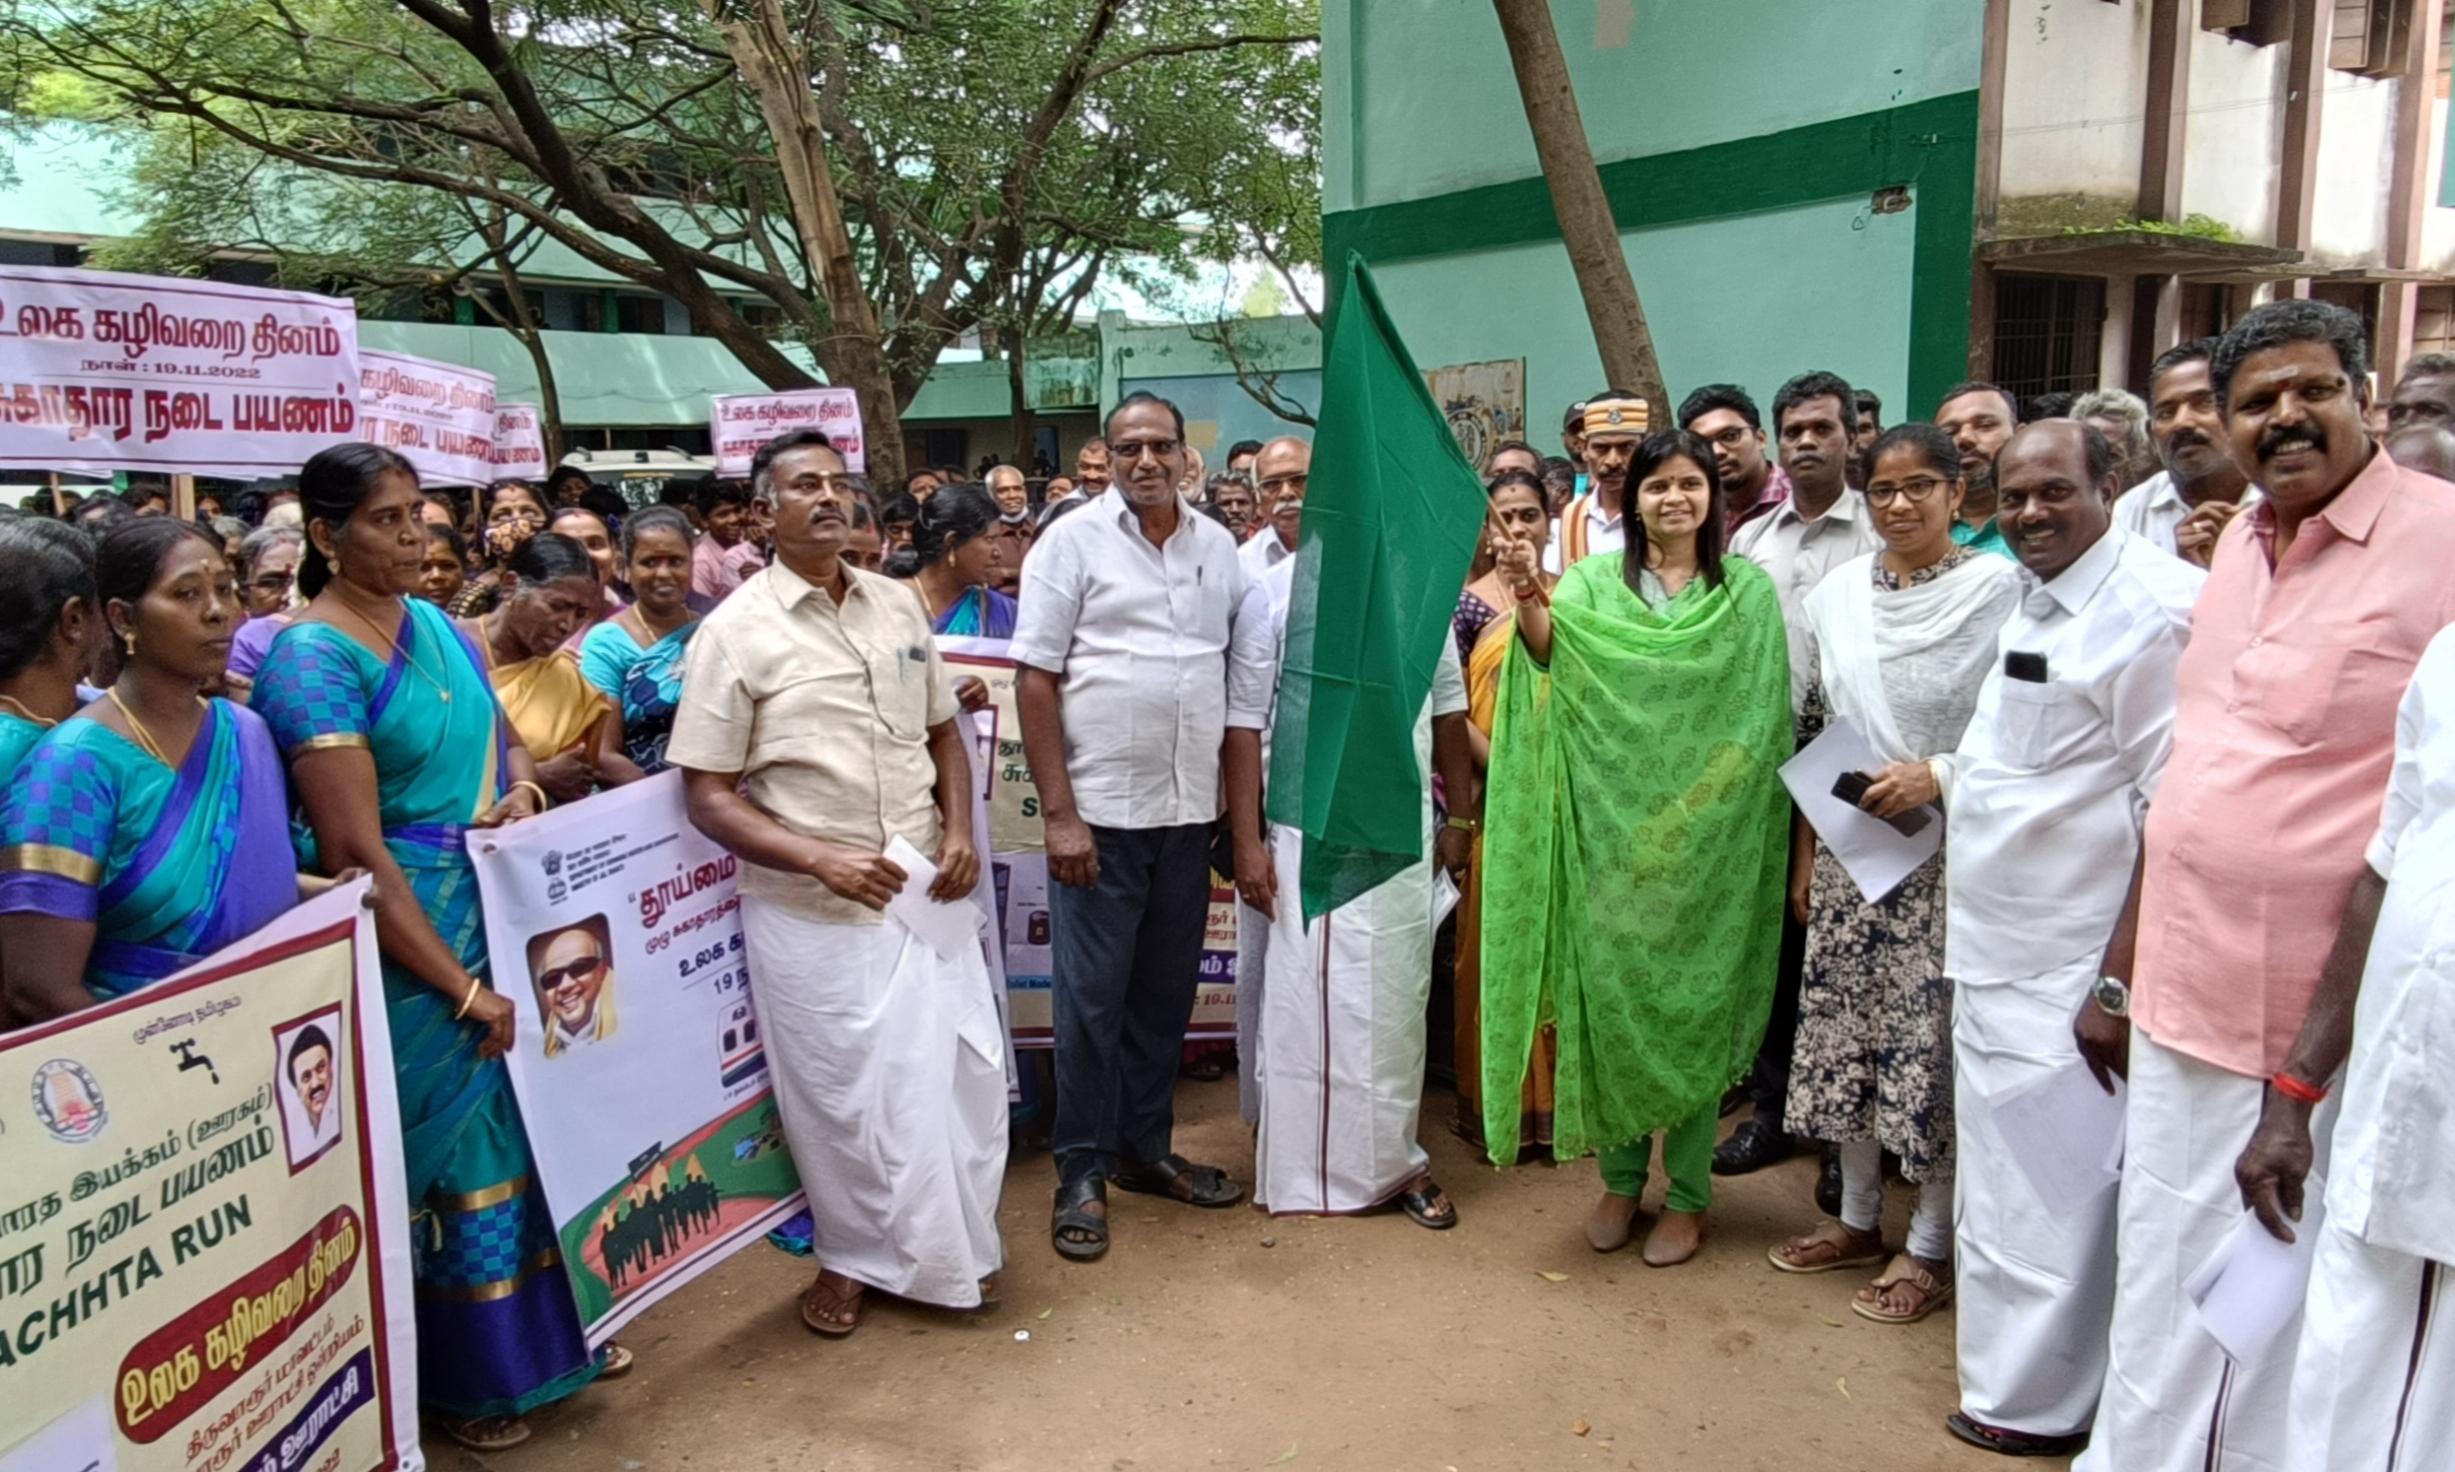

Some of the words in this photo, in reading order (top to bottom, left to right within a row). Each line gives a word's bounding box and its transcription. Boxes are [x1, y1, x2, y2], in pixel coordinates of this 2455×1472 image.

[94, 302, 245, 361] கழிவறை
[252, 313, 340, 364] தினம்
[80, 358, 137, 373] நாள்
[154, 363, 261, 379] 19.11.2022
[450, 381, 496, 414] தினம்
[144, 389, 223, 443] நடை
[233, 382, 354, 434] பயணம்
[679, 941, 726, 977] உலக
[65, 1194, 152, 1278] நடை
[161, 1114, 274, 1210] பயணம்
[70, 1129, 182, 1202] இயக்கம்
[170, 1193, 252, 1266] RUN
[122, 1344, 200, 1427] உலக
[308, 1216, 356, 1304] தினம்
[281, 1366, 359, 1470] ஊராட்சி
